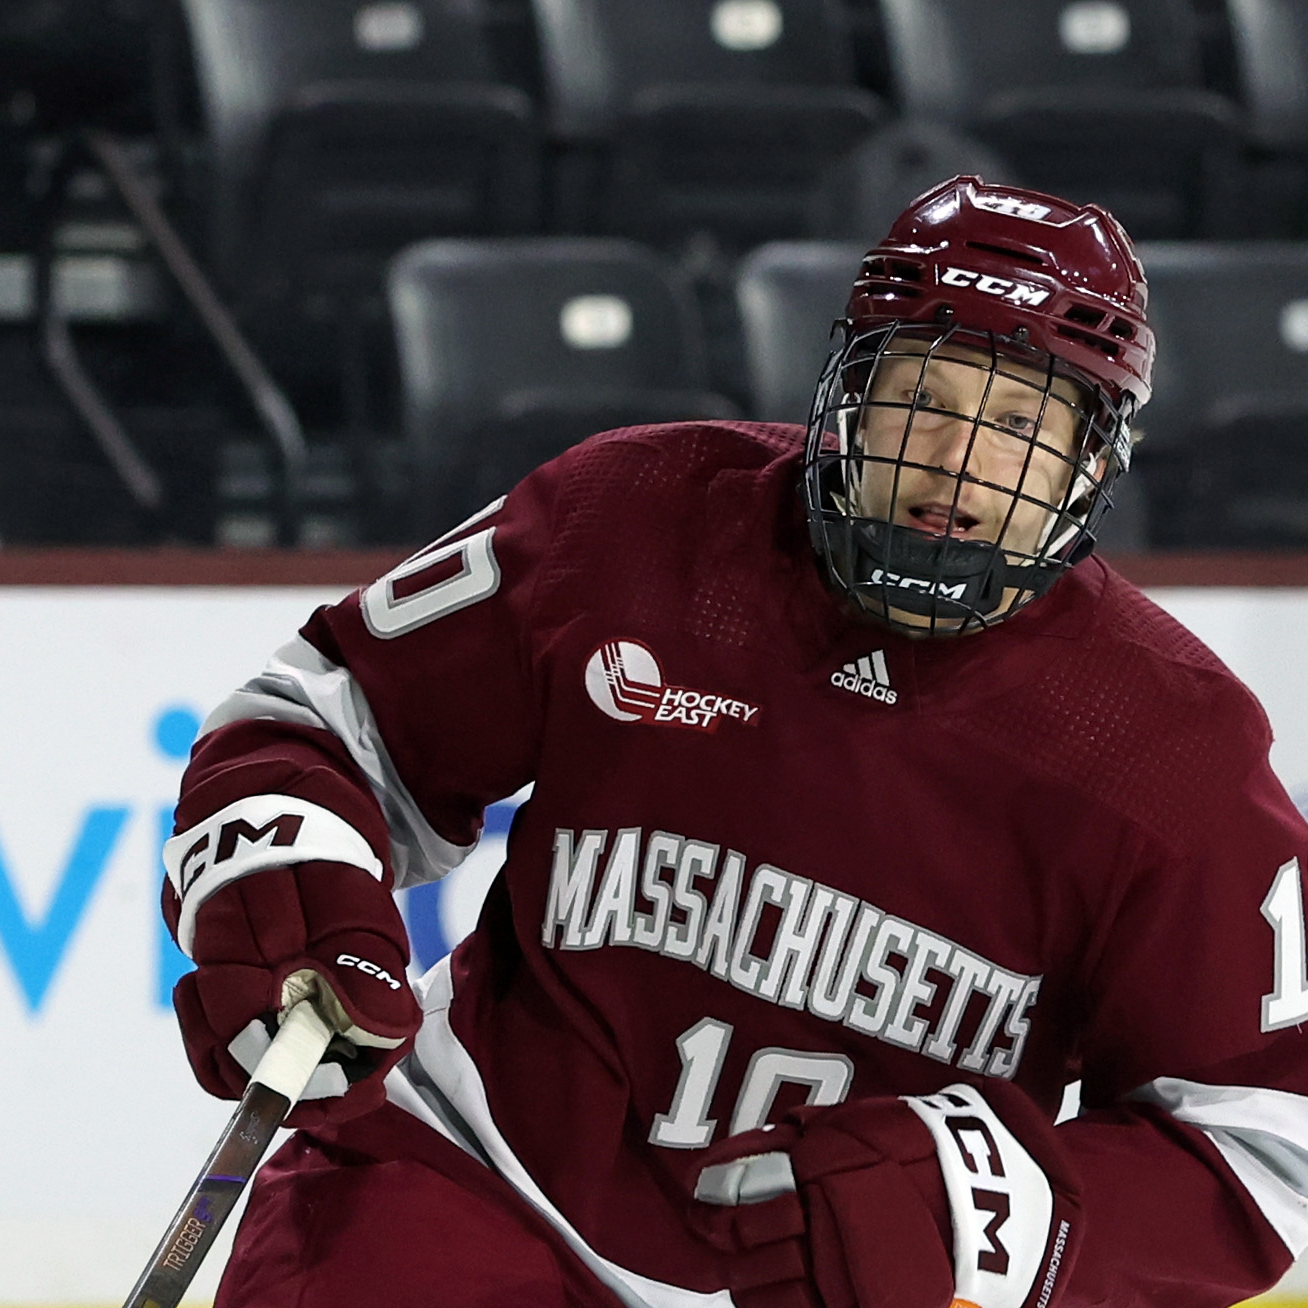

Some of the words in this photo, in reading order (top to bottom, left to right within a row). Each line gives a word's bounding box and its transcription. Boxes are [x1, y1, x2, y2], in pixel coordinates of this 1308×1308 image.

[941, 267, 1053, 306] CCM
[870, 568, 968, 600] CCM
[662, 688, 759, 722] HOCKEY
[830, 670, 898, 706] adidas
[654, 705, 718, 728] EAST
[542, 826, 1044, 1080] MASSACHUSETTS
[336, 954, 402, 990] CCM
[163, 1217, 207, 1272] TRIGGER
